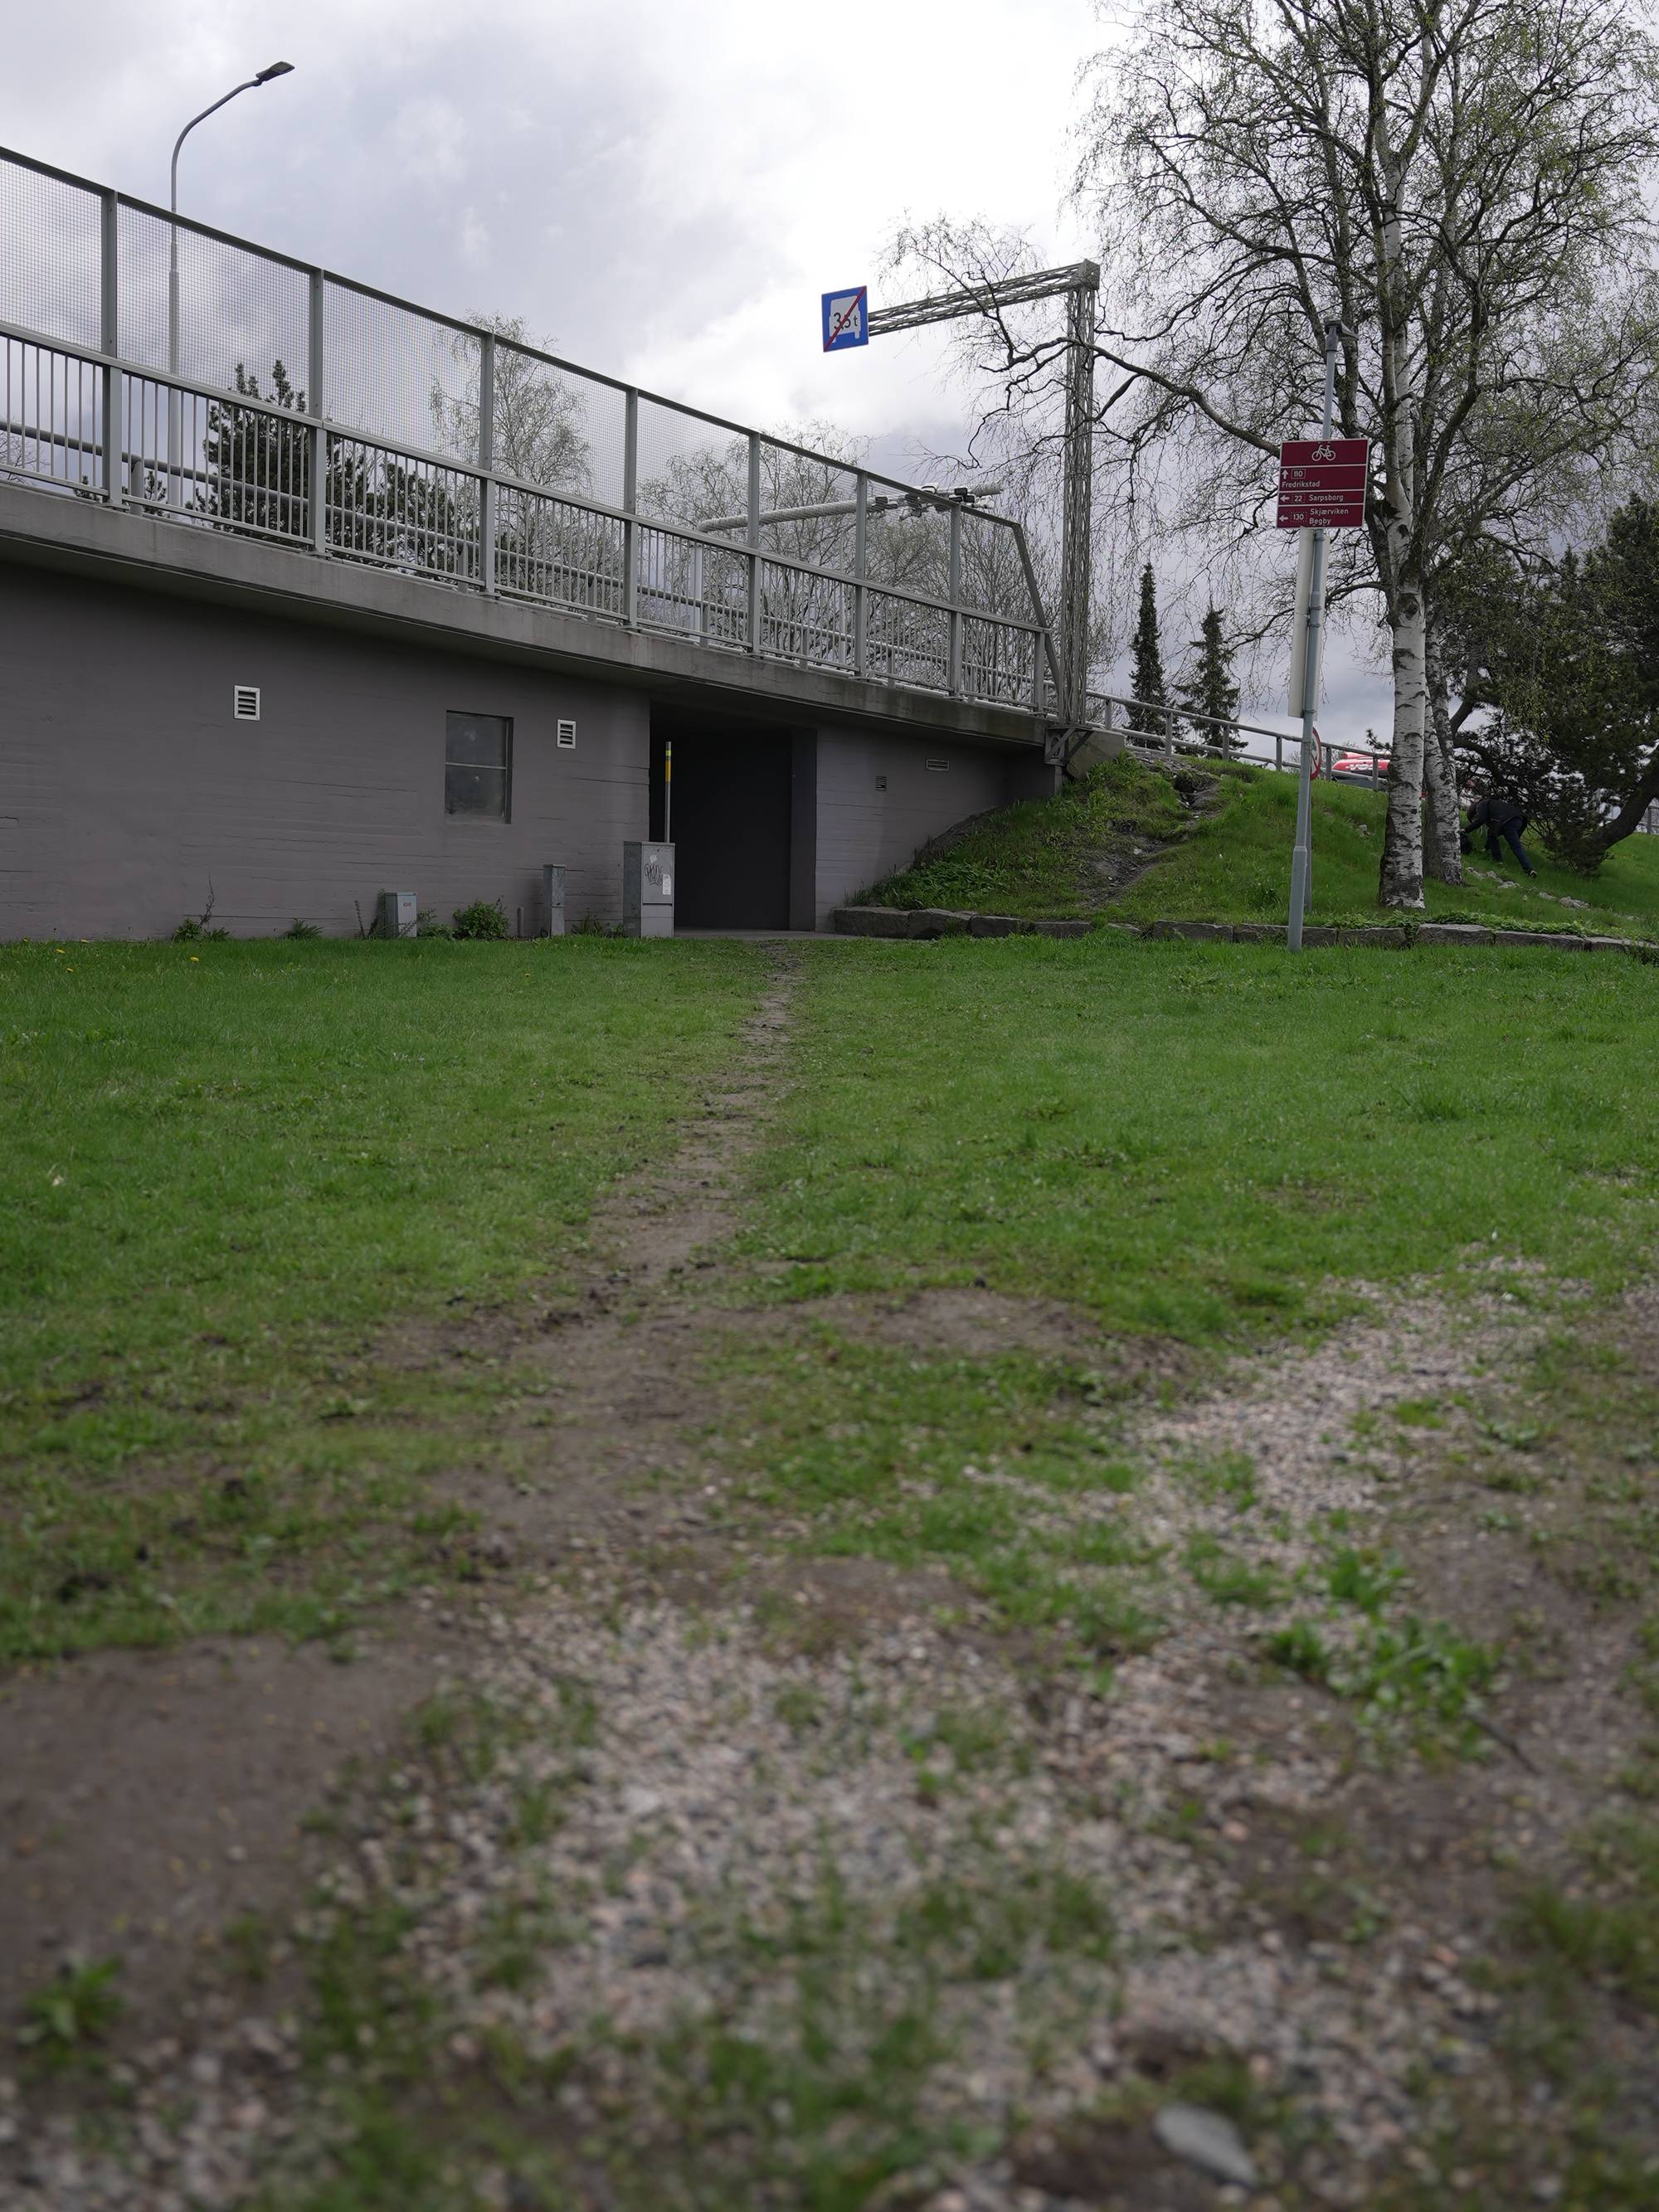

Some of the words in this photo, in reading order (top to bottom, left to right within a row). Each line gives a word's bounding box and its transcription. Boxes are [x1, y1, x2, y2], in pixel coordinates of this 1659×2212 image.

[854, 315, 858, 326] t
[1308, 494, 1344, 503] Sarpsborg
[1310, 508, 1349, 516] Skjærviken
